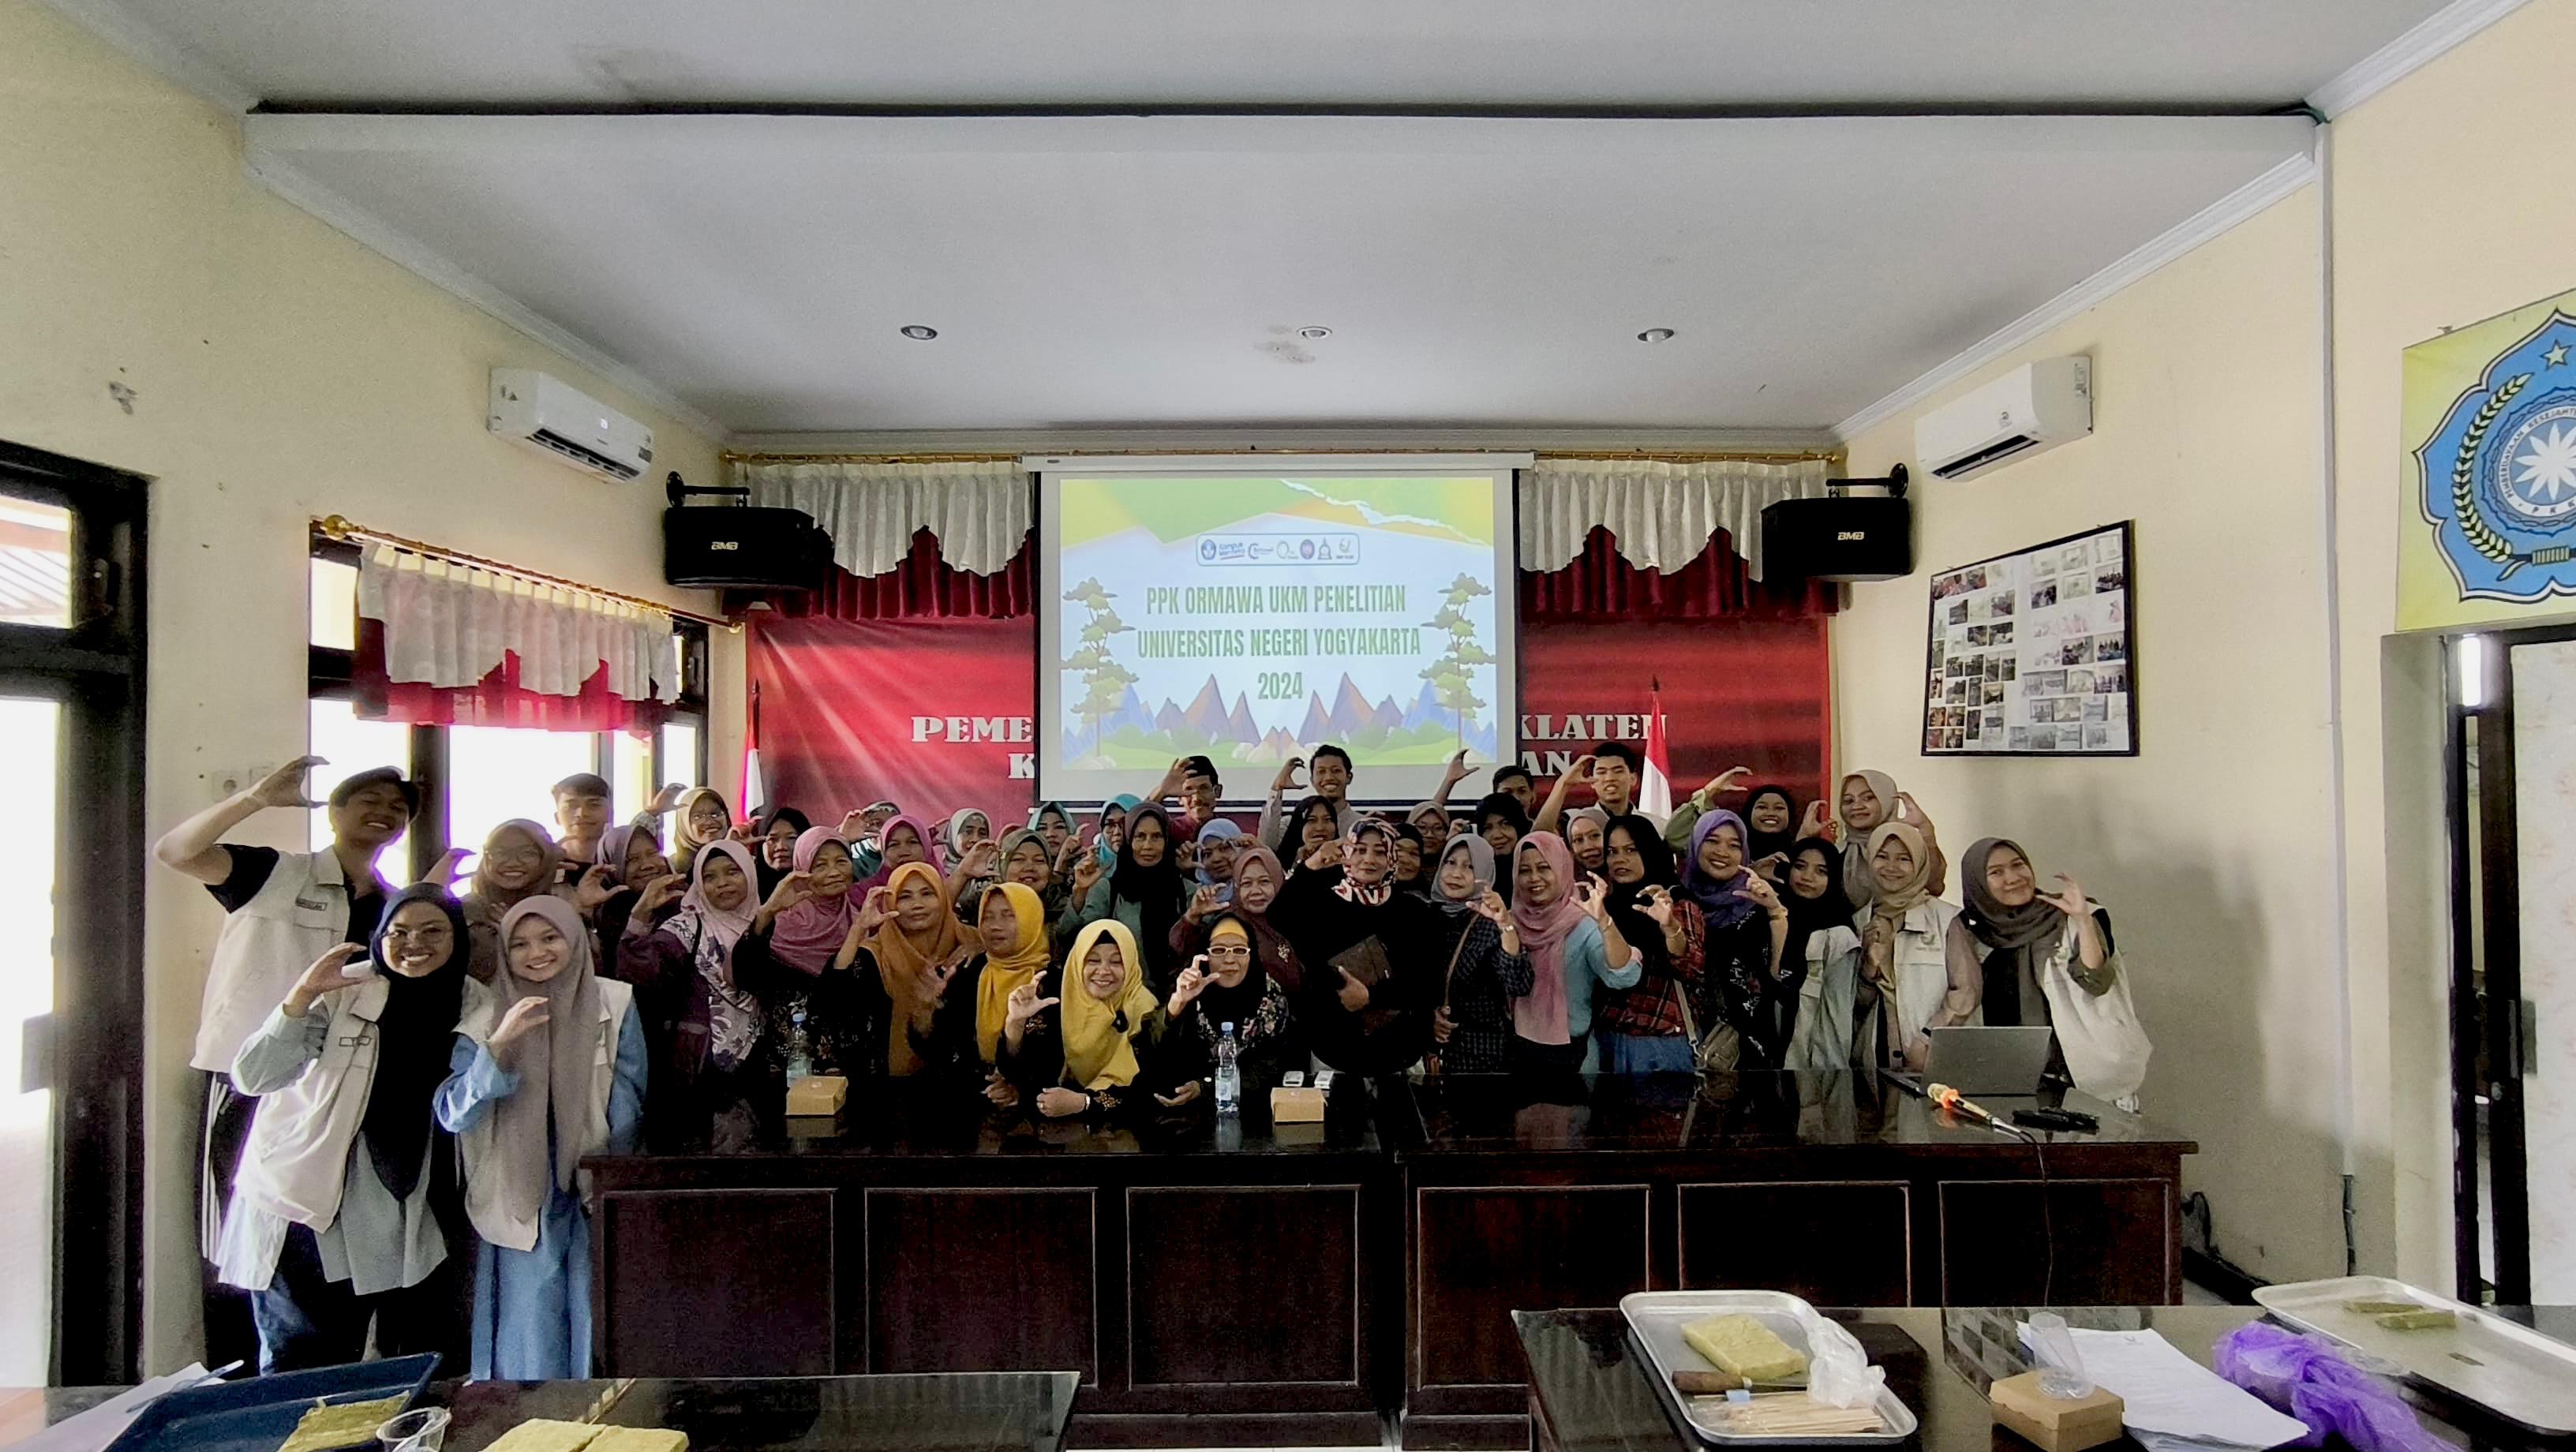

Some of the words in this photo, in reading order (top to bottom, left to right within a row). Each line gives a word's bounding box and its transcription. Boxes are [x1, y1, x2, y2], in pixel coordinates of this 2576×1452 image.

[1147, 586, 1180, 614] PPK
[1185, 586, 1264, 614] ORMAWA
[1269, 586, 1308, 612] UKM
[1314, 585, 1406, 612] PENELITIAN
[1138, 630, 1245, 657] UNIVERSITAS
[1250, 629, 1308, 657] NEGERI
[1314, 627, 1421, 655] YOGYAKARTA
[1257, 672, 1304, 699] 2024
